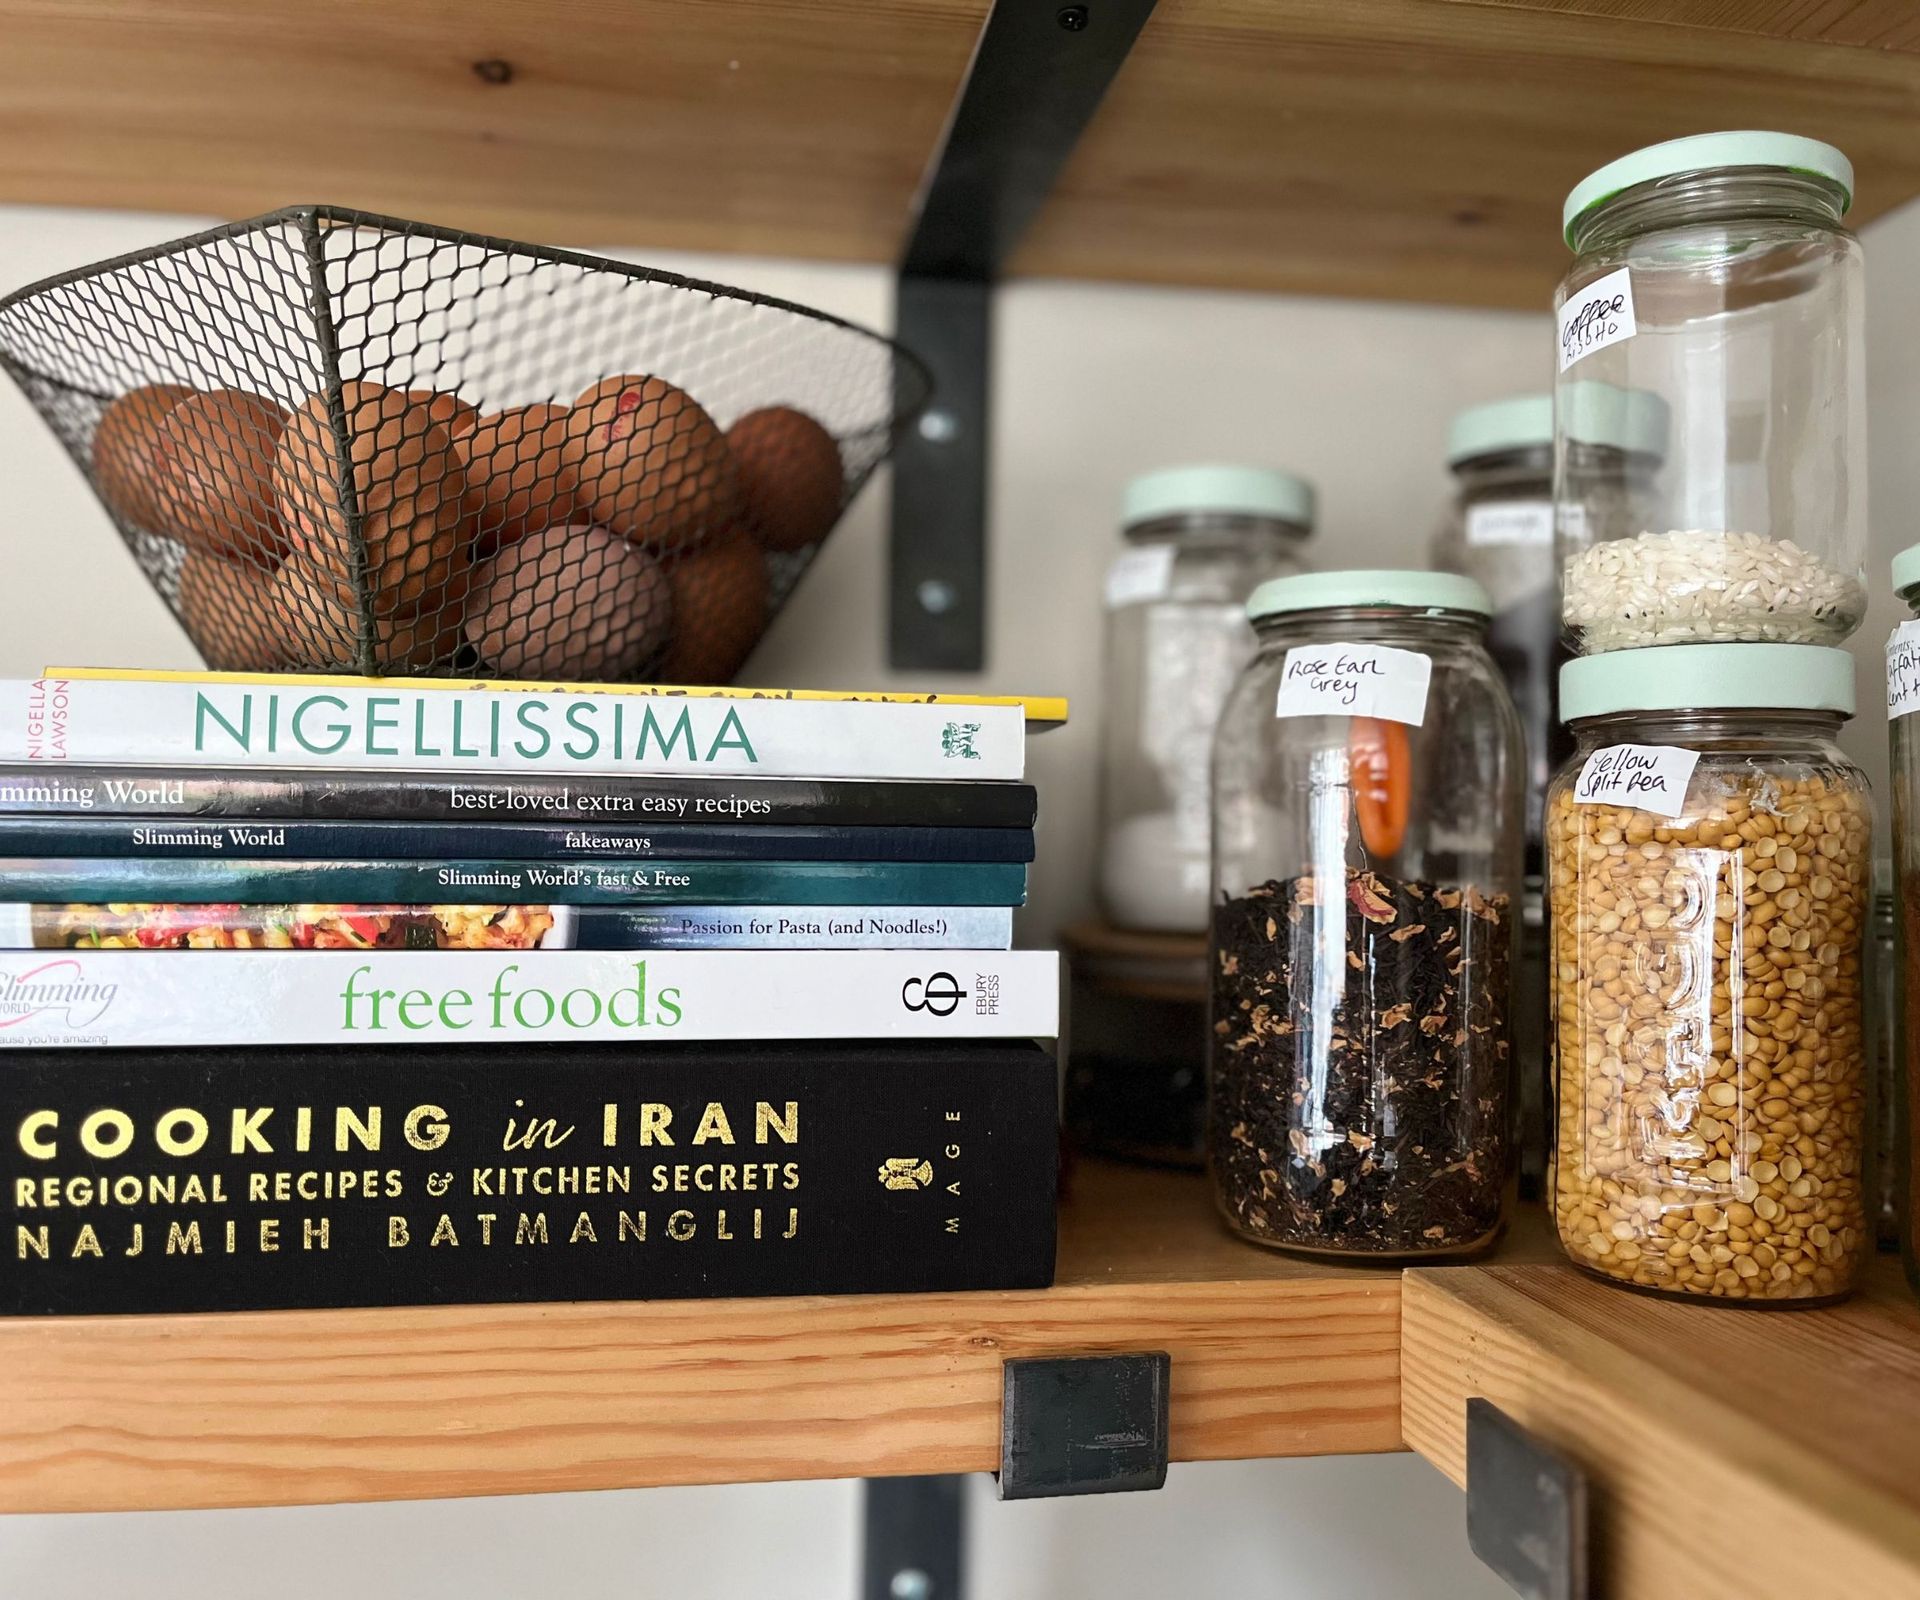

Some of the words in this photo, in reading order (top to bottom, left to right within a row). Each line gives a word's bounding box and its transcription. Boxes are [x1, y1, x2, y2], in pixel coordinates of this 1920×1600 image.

[1288, 659, 1328, 679] Rose
[1310, 677, 1358, 705] Grey
[28, 679, 46, 759] NIGELLA
[50, 680, 69, 759] LAWSON
[195, 691, 758, 764] NIGELLISSIMA
[1595, 749, 1658, 775] Yellow
[103, 781, 185, 804] World
[450, 786, 569, 812] best-loved
[577, 794, 634, 813] extra
[642, 798, 688, 818] easy
[696, 795, 771, 818] recipes
[133, 828, 223, 848] Slimming
[229, 829, 285, 846] World
[565, 831, 651, 850] fakeaways
[438, 869, 521, 888] Slimming
[527, 869, 591, 887] World's
[597, 870, 627, 888] fast
[633, 872, 649, 886] &
[654, 872, 690, 887] Free
[681, 919, 743, 936] Passion
[750, 919, 772, 934] for
[779, 920, 821, 934] Pasta
[828, 919, 863, 936] (and
[870, 919, 947, 936] Noodles!)
[340, 966, 473, 1030] free
[488, 960, 682, 1029] foods
[976, 973, 986, 1015] EBURY
[988, 975, 999, 1015] PRESS
[63, 1035, 108, 1045] amazing
[18, 1105, 451, 1160] COOKING
[502, 1099, 575, 1152] in
[603, 1102, 798, 1147] IRAN
[15, 1174, 228, 1207] REGIONAL
[250, 1170, 402, 1201] RECIPES
[427, 1172, 454, 1197] &
[473, 1164, 630, 1196] KITCHEN
[652, 1163, 799, 1193] SECRETS
[945, 1111, 961, 1234] MAGE
[17, 1217, 330, 1259] NAJMIEH
[388, 1208, 798, 1248] BATMANGLIJ
